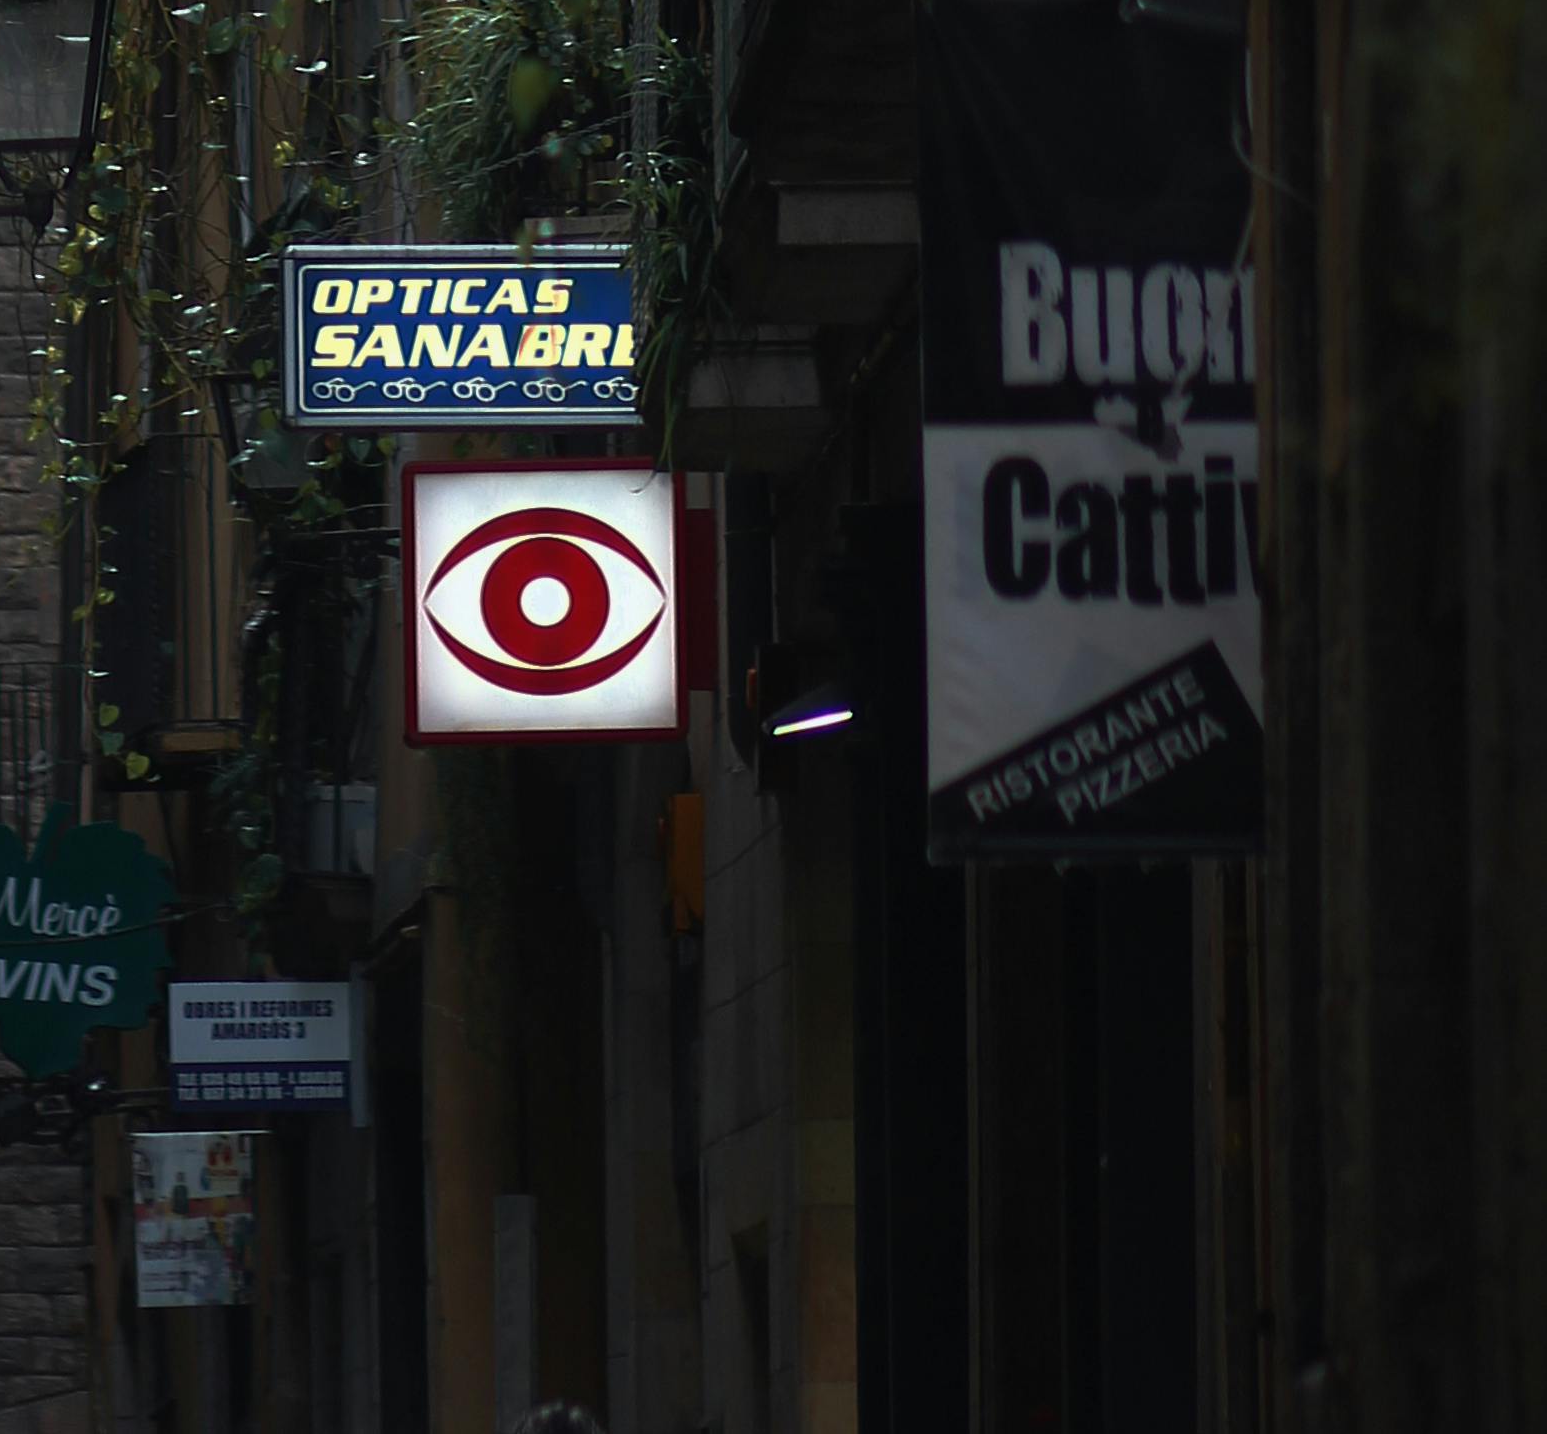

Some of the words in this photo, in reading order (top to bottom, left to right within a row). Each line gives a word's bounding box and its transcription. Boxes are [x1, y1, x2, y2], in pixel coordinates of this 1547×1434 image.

[312, 278, 573, 315] OPTICAS
[965, 666, 1205, 824] RISTORANTE
[1054, 712, 1228, 825] PIZZERIA
[183, 1001, 236, 1018] OBRES
[251, 1000, 333, 1017] REFORMES
[297, 1022, 306, 1039] 3
